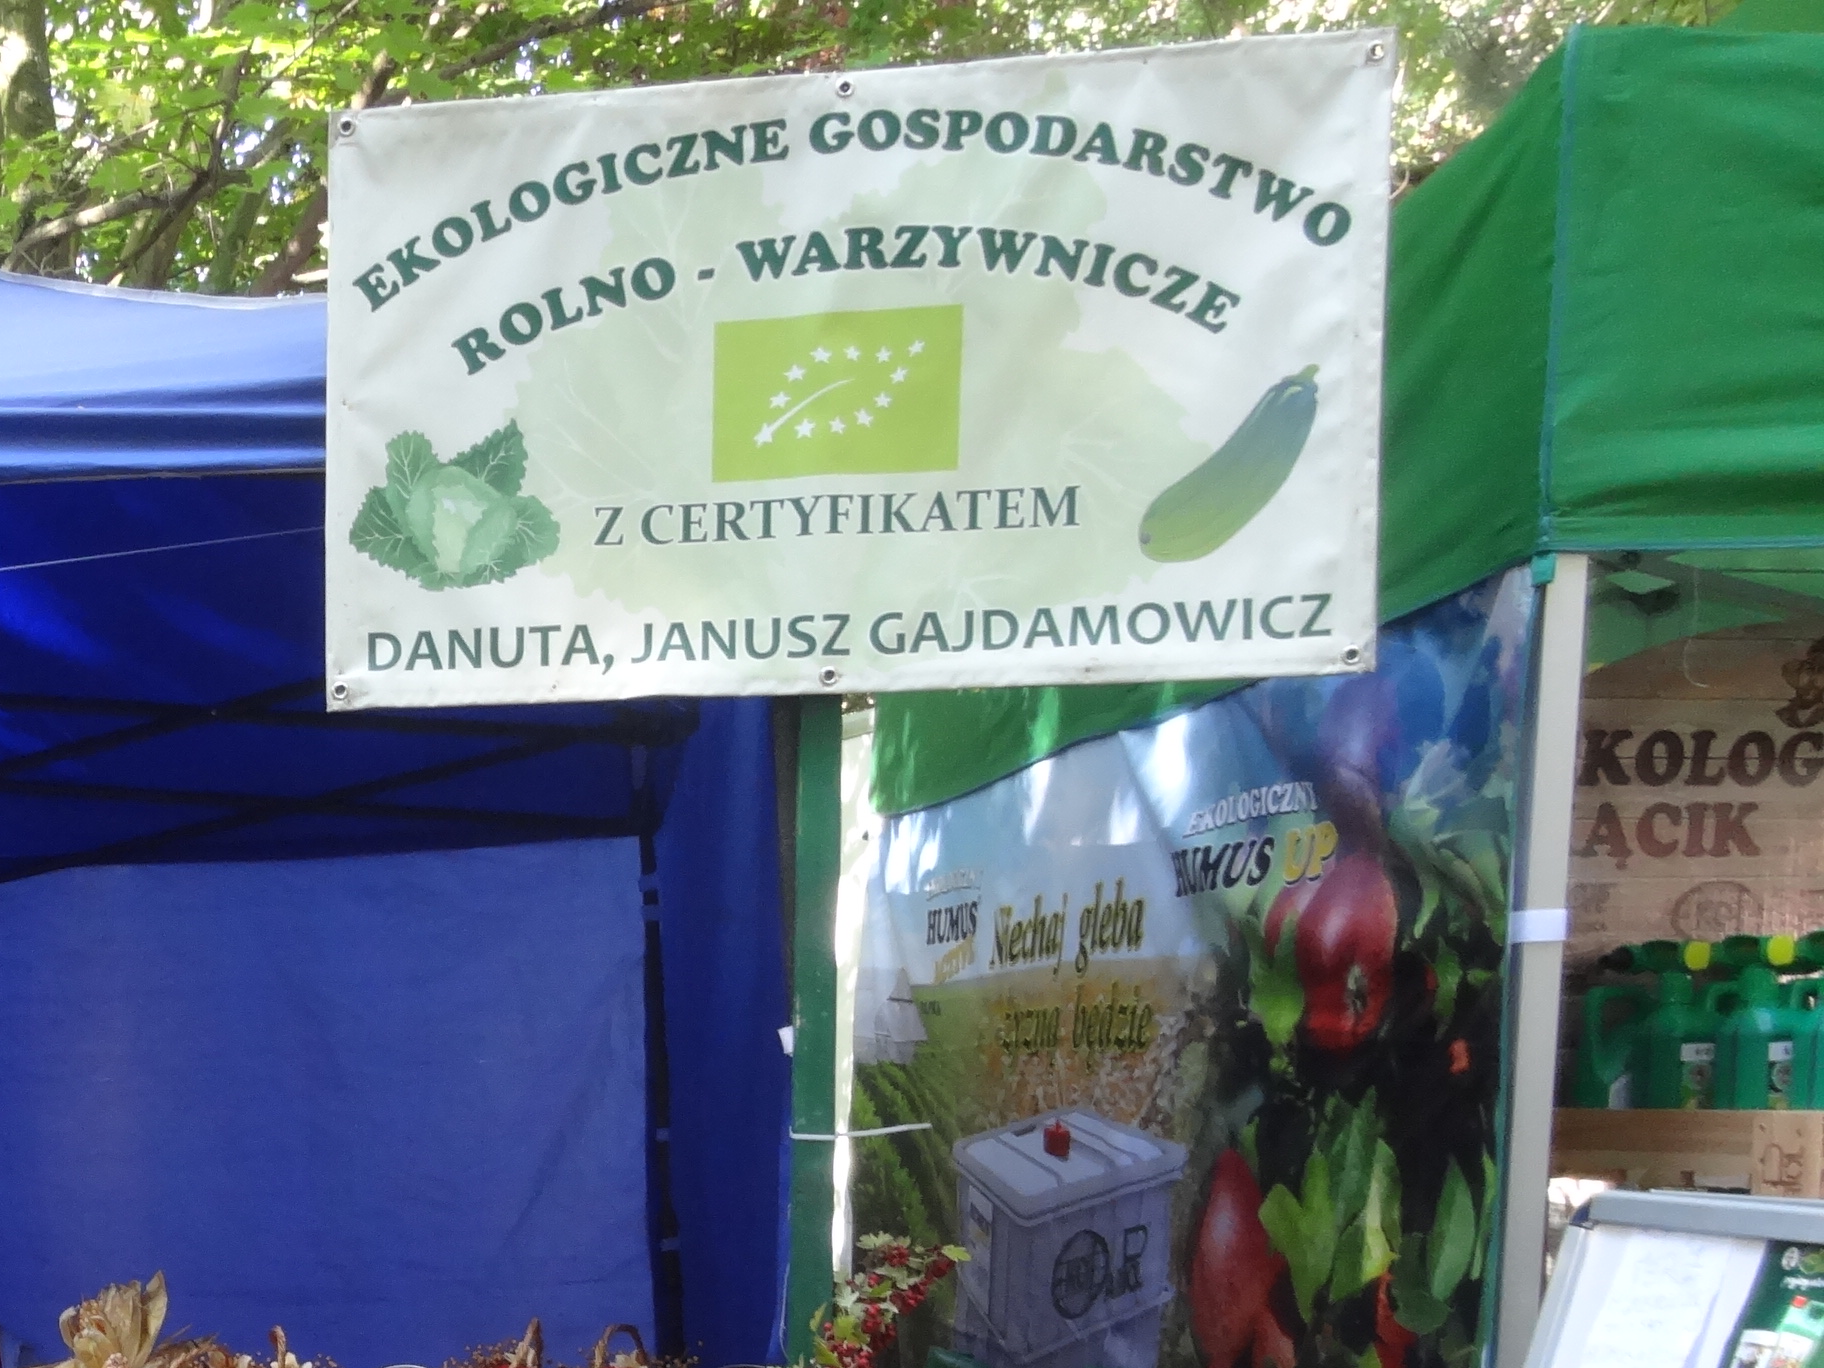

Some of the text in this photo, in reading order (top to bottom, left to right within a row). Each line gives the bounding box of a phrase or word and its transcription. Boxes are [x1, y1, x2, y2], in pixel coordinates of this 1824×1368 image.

[352, 108, 1352, 312] EKOLOGICZNE GOSPODARSTWO
[450, 257, 677, 375] ROLNO
[736, 225, 1241, 334] WARZYWNICZE
[593, 484, 1081, 546] Z CERTYFIKATEM
[366, 592, 1333, 675] DANUTA, JANUSZ GAJDAMOWICZ
[1576, 729, 1824, 787] KOLOG
[1283, 821, 1339, 886] UP
[1572, 801, 1761, 870] ĄCIK
[926, 900, 978, 945] HUMUS
[989, 892, 1069, 980] Niechaj
[1075, 876, 1145, 977] gleba
